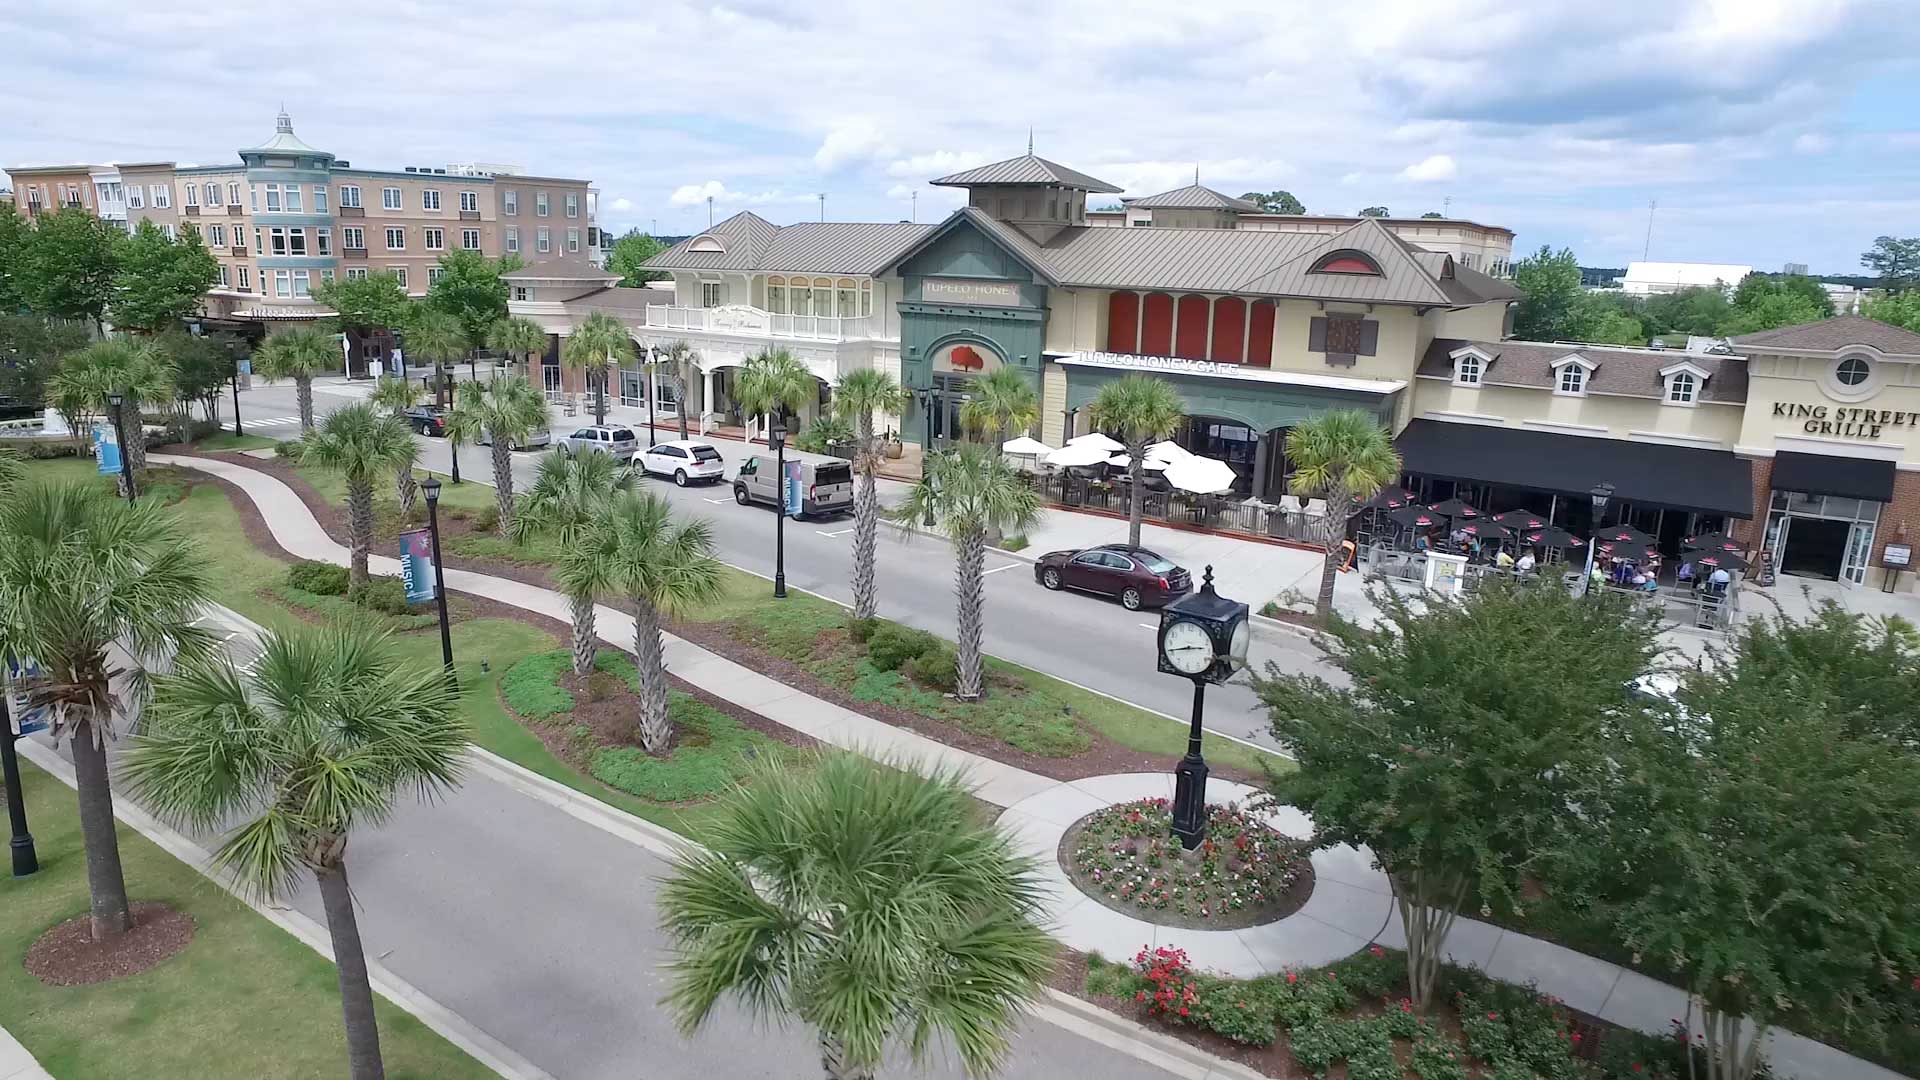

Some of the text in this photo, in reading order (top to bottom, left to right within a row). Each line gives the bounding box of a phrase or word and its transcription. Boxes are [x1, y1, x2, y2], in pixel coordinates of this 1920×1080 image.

[926, 282, 1017, 296] TUPELO HONEY
[1080, 351, 1132, 366] TUPELO
[1137, 355, 1194, 371] HONEY
[1772, 402, 1920, 426] KING STREET
[1804, 419, 1882, 438] GRILLE
[400, 553, 414, 591] MUSIC
